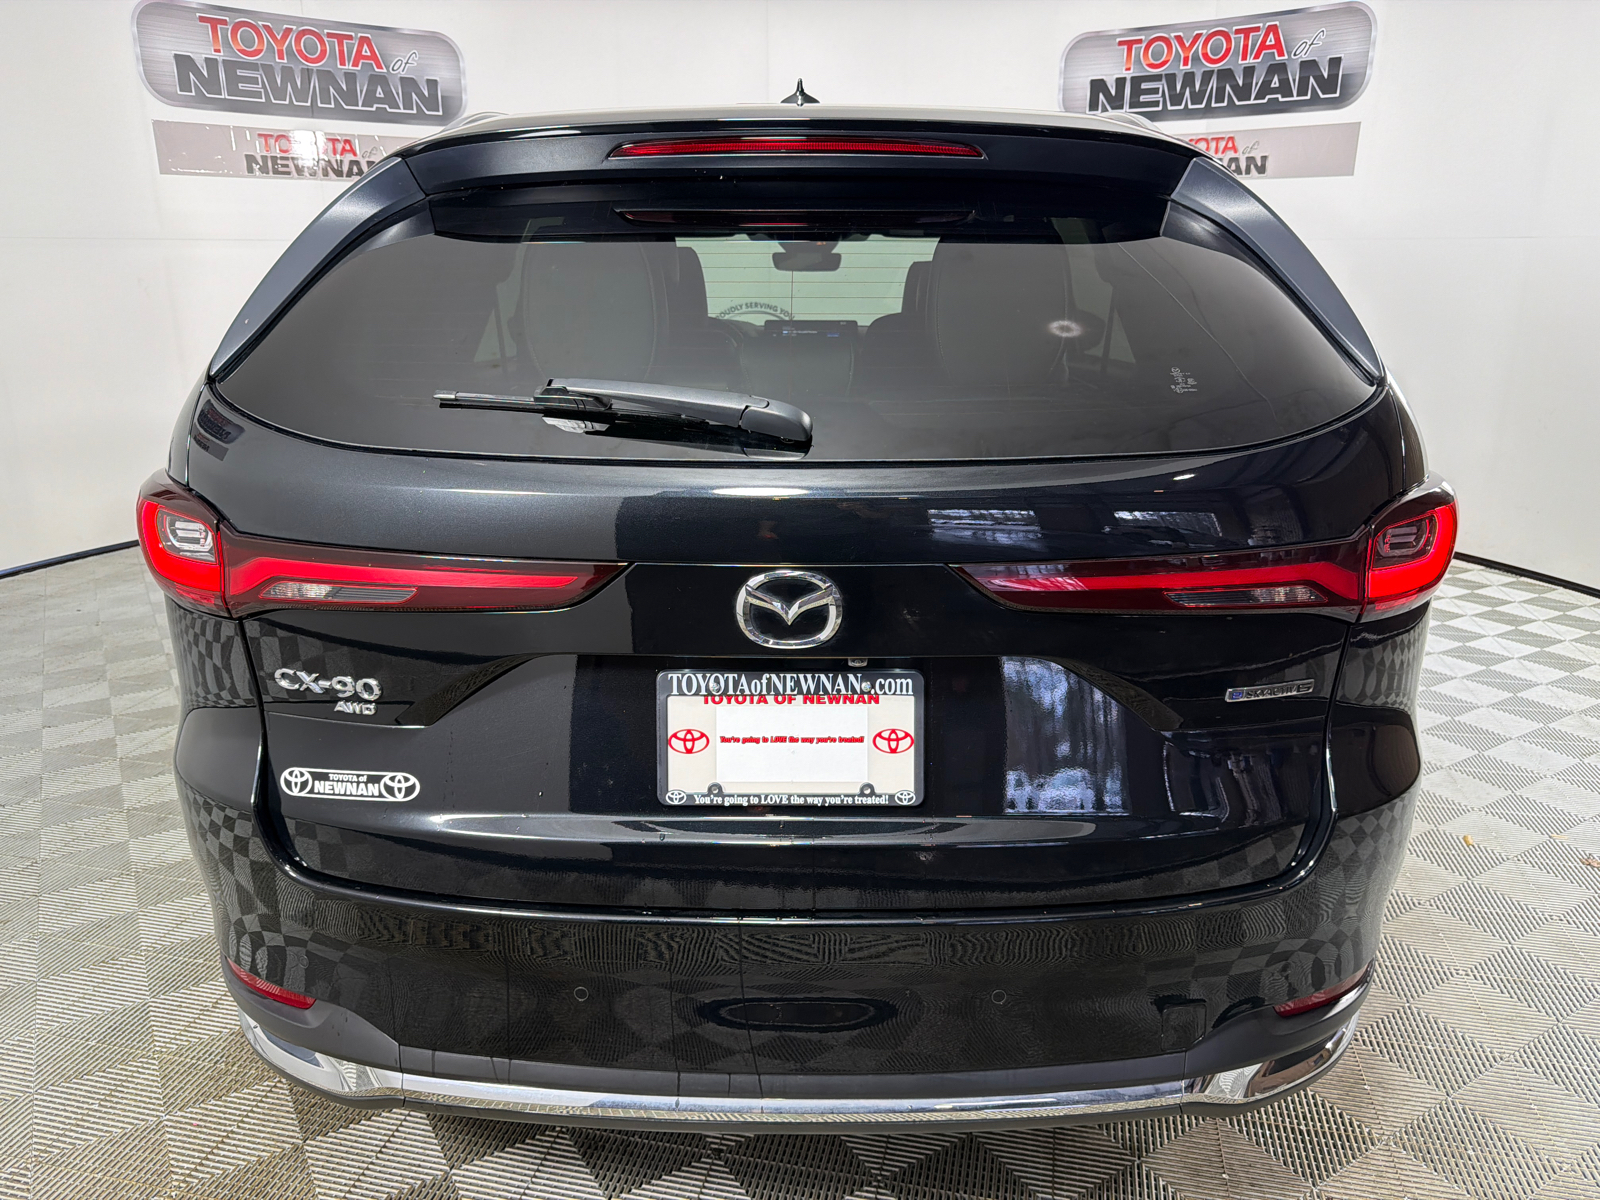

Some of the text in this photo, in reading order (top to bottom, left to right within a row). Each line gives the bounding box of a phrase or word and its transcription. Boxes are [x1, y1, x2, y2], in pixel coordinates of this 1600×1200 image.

[196, 13, 418, 75] TOYOTA of
[1116, 21, 1326, 72] TOYOTA of
[172, 52, 443, 116] NEWNAN
[1086, 55, 1344, 115] NEWNAN
[257, 132, 358, 158] TOTA
[744, 301, 779, 313] SERVING
[274, 667, 383, 701] CX-90
[333, 700, 377, 716] AWD
[703, 694, 880, 705] TOYOTA OF NEWNAN
[720, 736, 865, 745] You're going to LOVE the way you're treated!
[328, 774, 368, 783] TOYOTA of
[314, 780, 380, 797] NEWNAN
[693, 794, 889, 806] You're going to LOVE the way you're treated!
